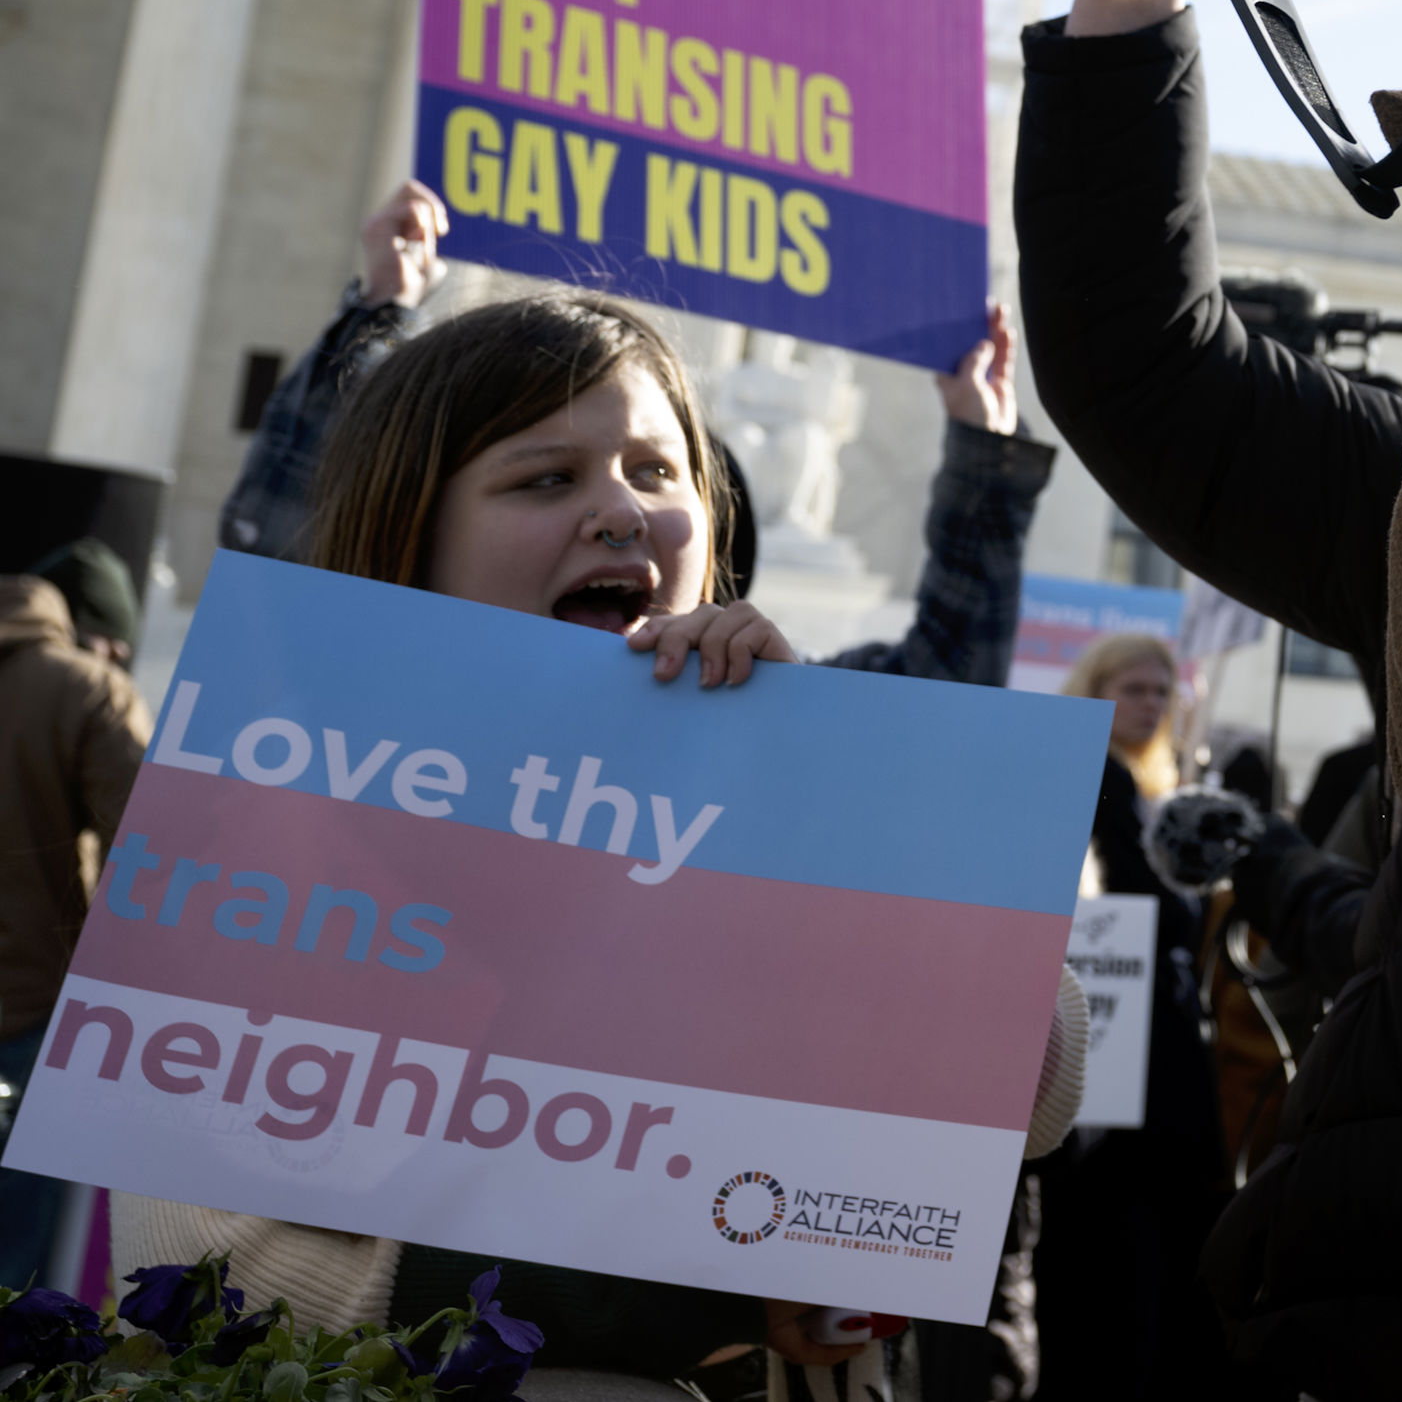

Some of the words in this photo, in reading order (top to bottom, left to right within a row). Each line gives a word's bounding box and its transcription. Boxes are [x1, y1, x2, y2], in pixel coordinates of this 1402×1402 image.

[443, 105, 620, 246] GAY
[645, 152, 831, 296] KIDS
[152, 681, 469, 819] Love
[509, 754, 725, 886] thy
[103, 831, 455, 974] trans
[45, 998, 694, 1180] neighbor.
[783, 1230, 837, 1247] ACHIEVING
[840, 1238, 899, 1255] DEMOCRACY
[903, 1246, 953, 1262] TOGETHER
[788, 1209, 958, 1249] ALLIANCE
[794, 1189, 961, 1227] INTERFAITH
